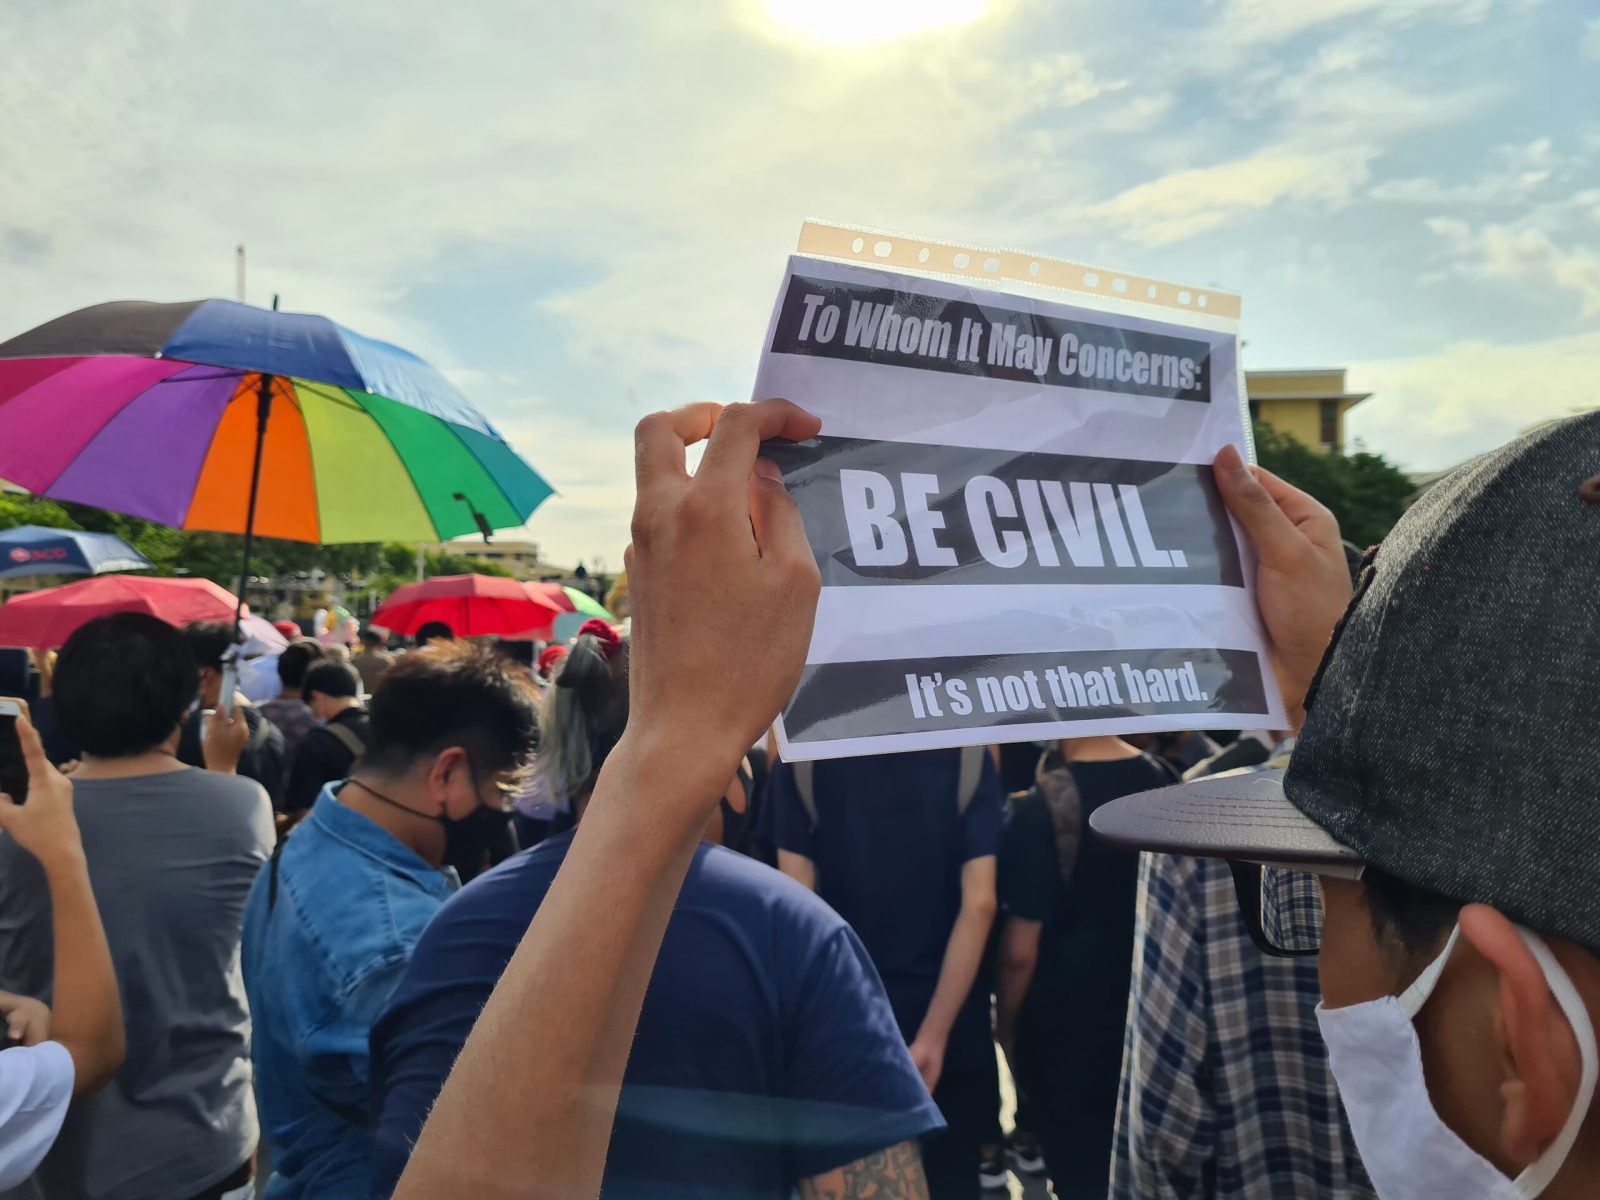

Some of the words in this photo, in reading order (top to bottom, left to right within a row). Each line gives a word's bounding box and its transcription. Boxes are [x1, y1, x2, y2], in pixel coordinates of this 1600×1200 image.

[798, 293, 841, 343] To
[845, 300, 953, 359] Whom
[957, 317, 984, 363] It
[987, 322, 1053, 376] May
[1058, 333, 1202, 390] Concerns:
[839, 468, 959, 567] BE
[963, 475, 1189, 568] CIVIL.
[905, 672, 972, 718] It's
[977, 668, 1045, 714] not
[1047, 664, 1120, 708] that
[1121, 661, 1208, 704] hard.
